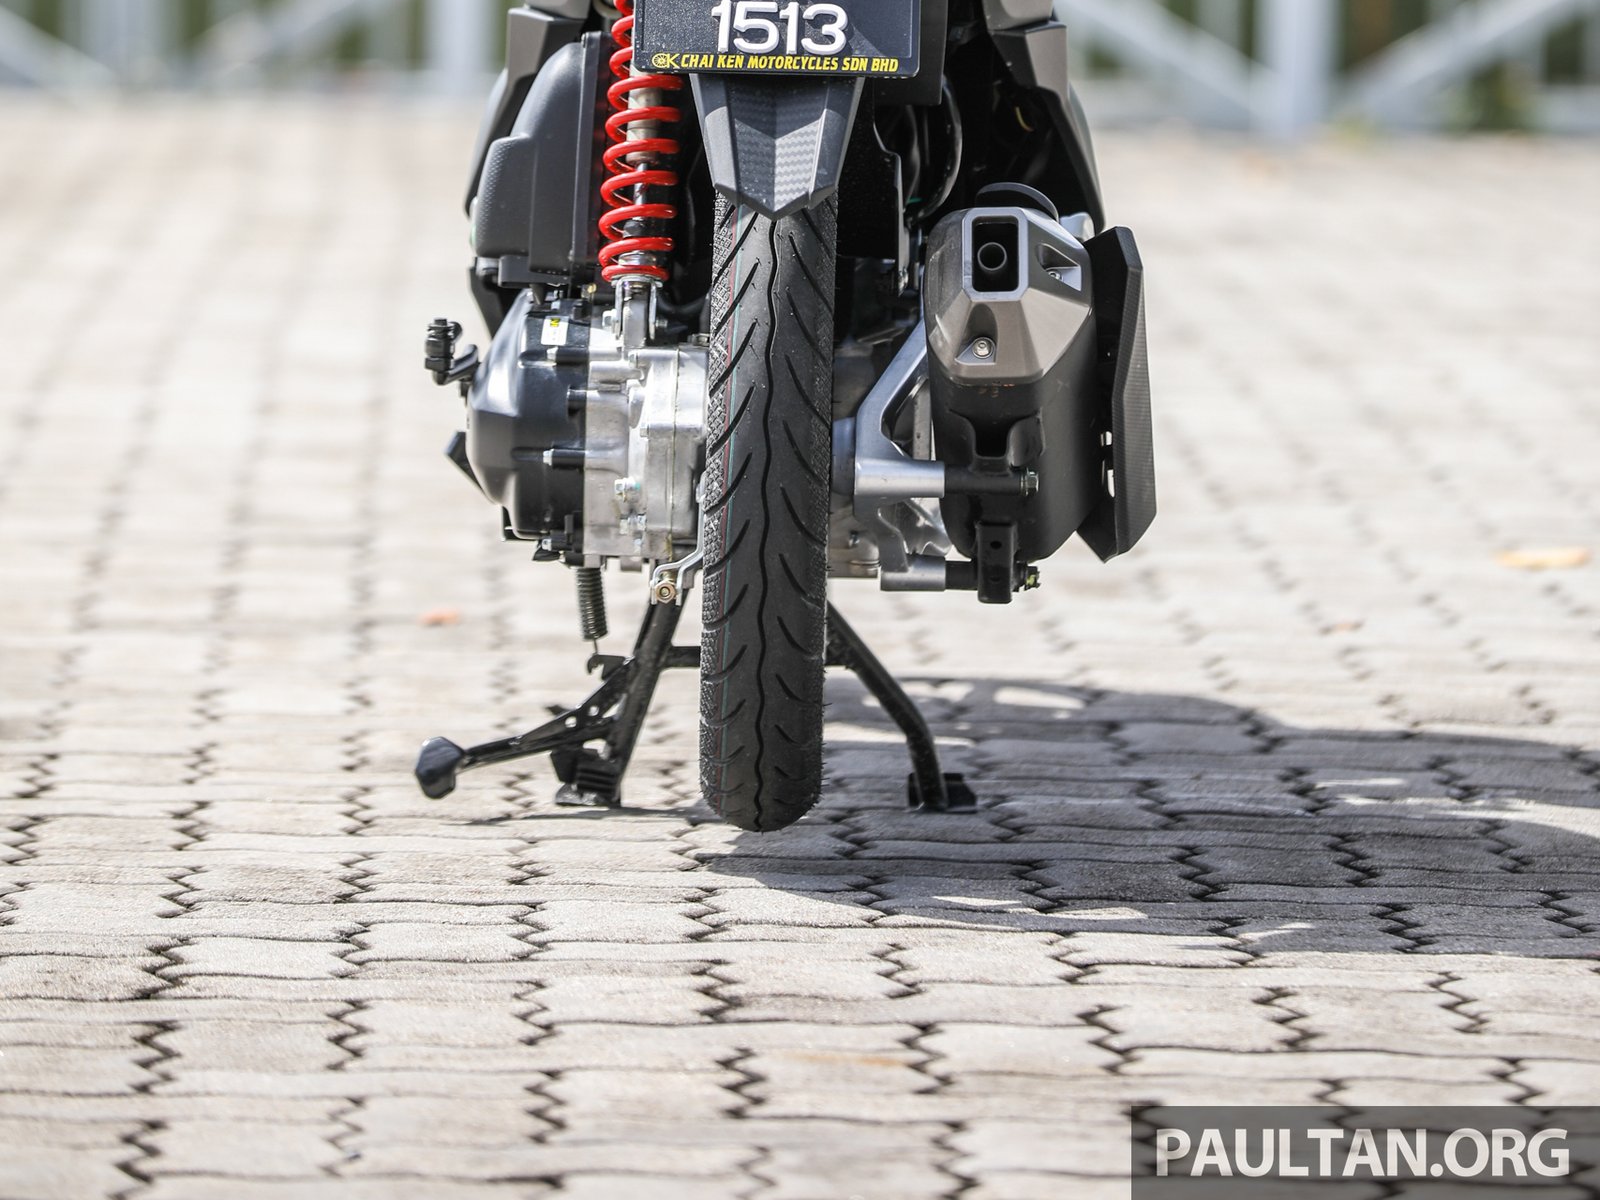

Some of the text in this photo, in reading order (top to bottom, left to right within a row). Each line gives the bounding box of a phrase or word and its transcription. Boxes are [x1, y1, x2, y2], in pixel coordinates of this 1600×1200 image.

[711, 0, 848, 55] 1513
[681, 53, 714, 68] CHAI
[717, 54, 743, 69] KEN
[747, 55, 838, 71] MOTORCYCLES
[842, 57, 868, 71] SDN
[871, 58, 899, 72] BHD
